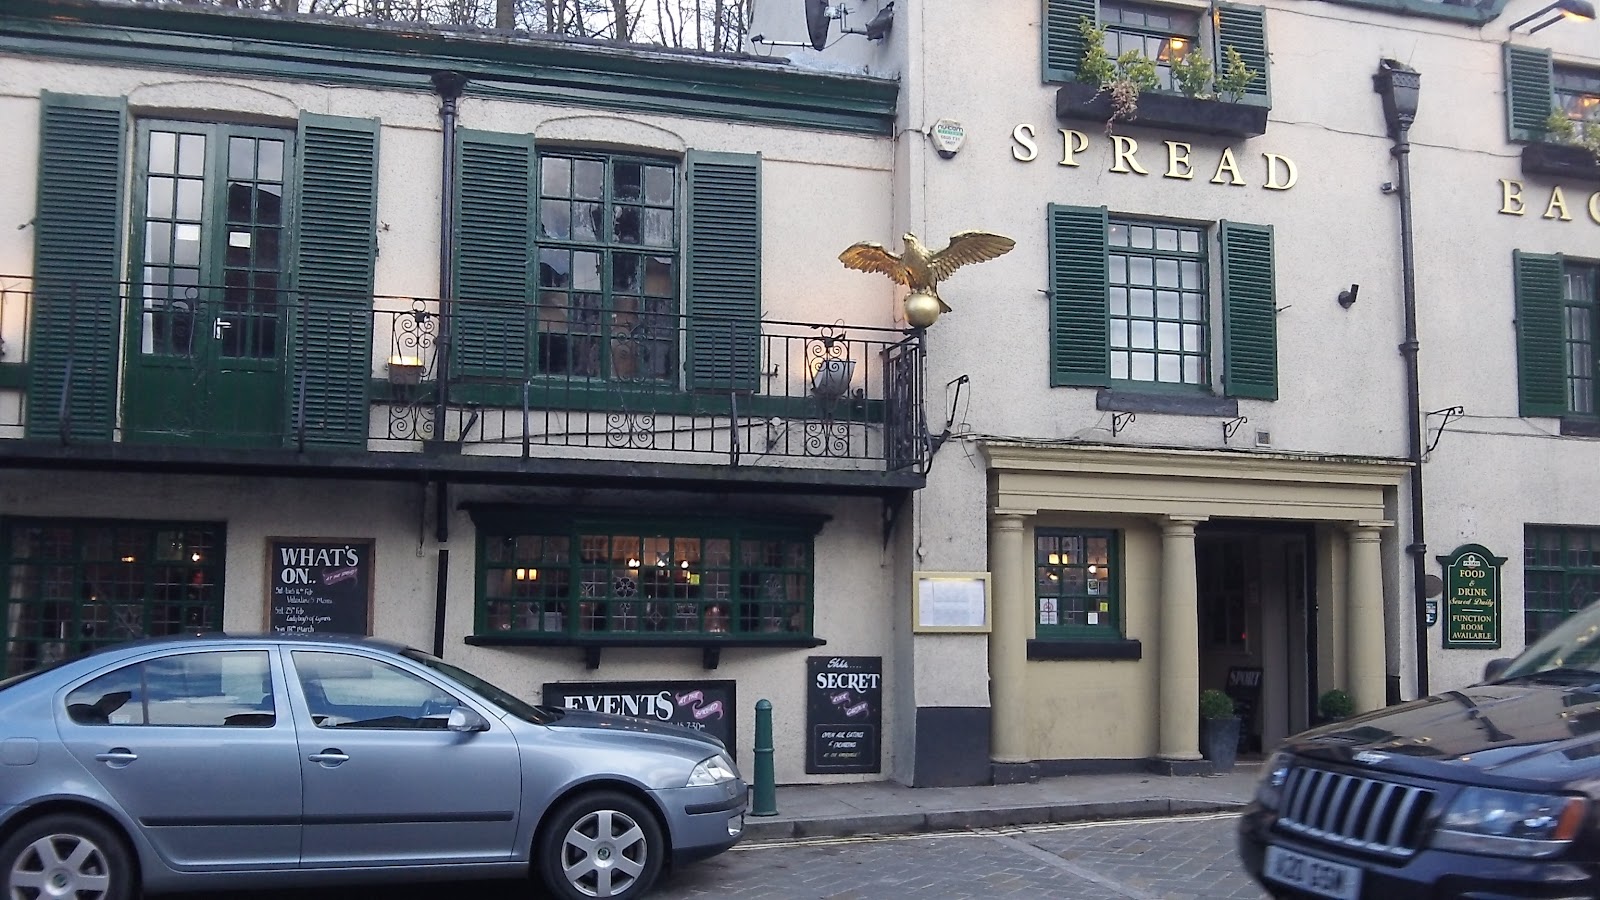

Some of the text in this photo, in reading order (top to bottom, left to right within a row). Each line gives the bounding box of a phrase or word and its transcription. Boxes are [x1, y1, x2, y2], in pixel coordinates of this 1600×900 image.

[1011, 122, 1299, 191] SPREAD
[280, 545, 359, 567] WHAT'S
[1459, 569, 1486, 578] FOOD
[1468, 579, 1476, 587] &
[1457, 587, 1488, 597] DRINK
[1452, 614, 1492, 622] FUNCTION
[1460, 623, 1484, 631] ROOM
[815, 672, 881, 694] SECRET
[563, 691, 674, 721] EVENTS
